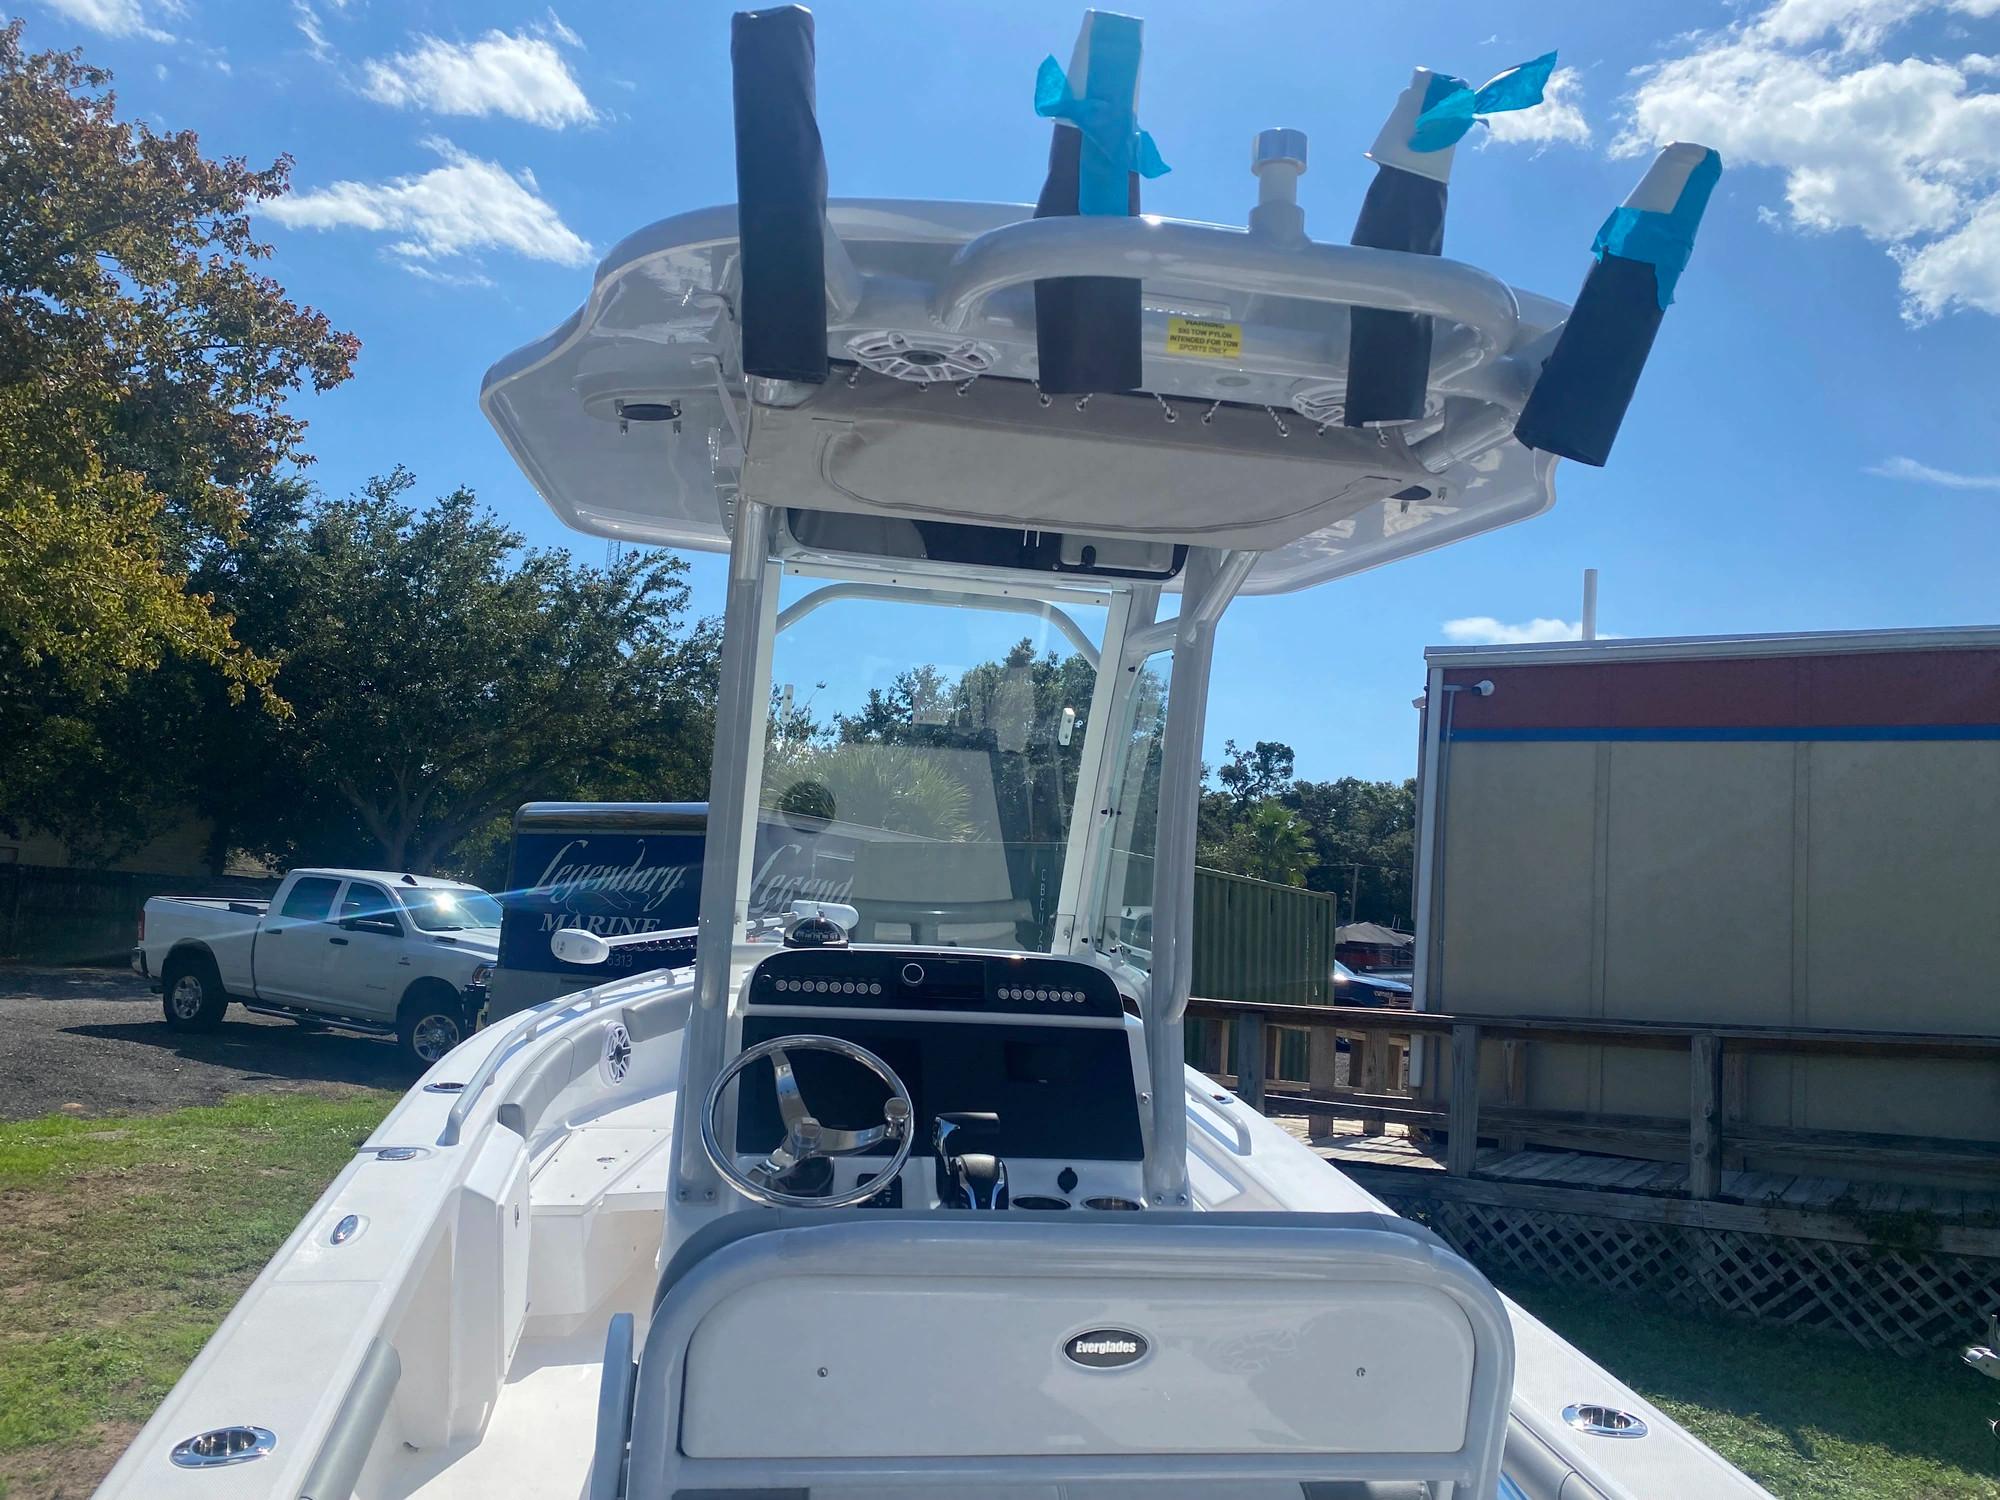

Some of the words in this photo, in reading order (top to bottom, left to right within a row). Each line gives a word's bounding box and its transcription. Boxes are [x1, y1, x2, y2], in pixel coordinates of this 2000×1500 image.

[1169, 335, 1205, 344] INTENDED
[1191, 329, 1207, 337] TOW
[1208, 331, 1232, 339] PYLON
[1179, 344, 1207, 352] SPORTS
[526, 838, 688, 912] Legendary
[538, 911, 661, 936] MARINE
[1075, 1340, 1137, 1355] Everglades
